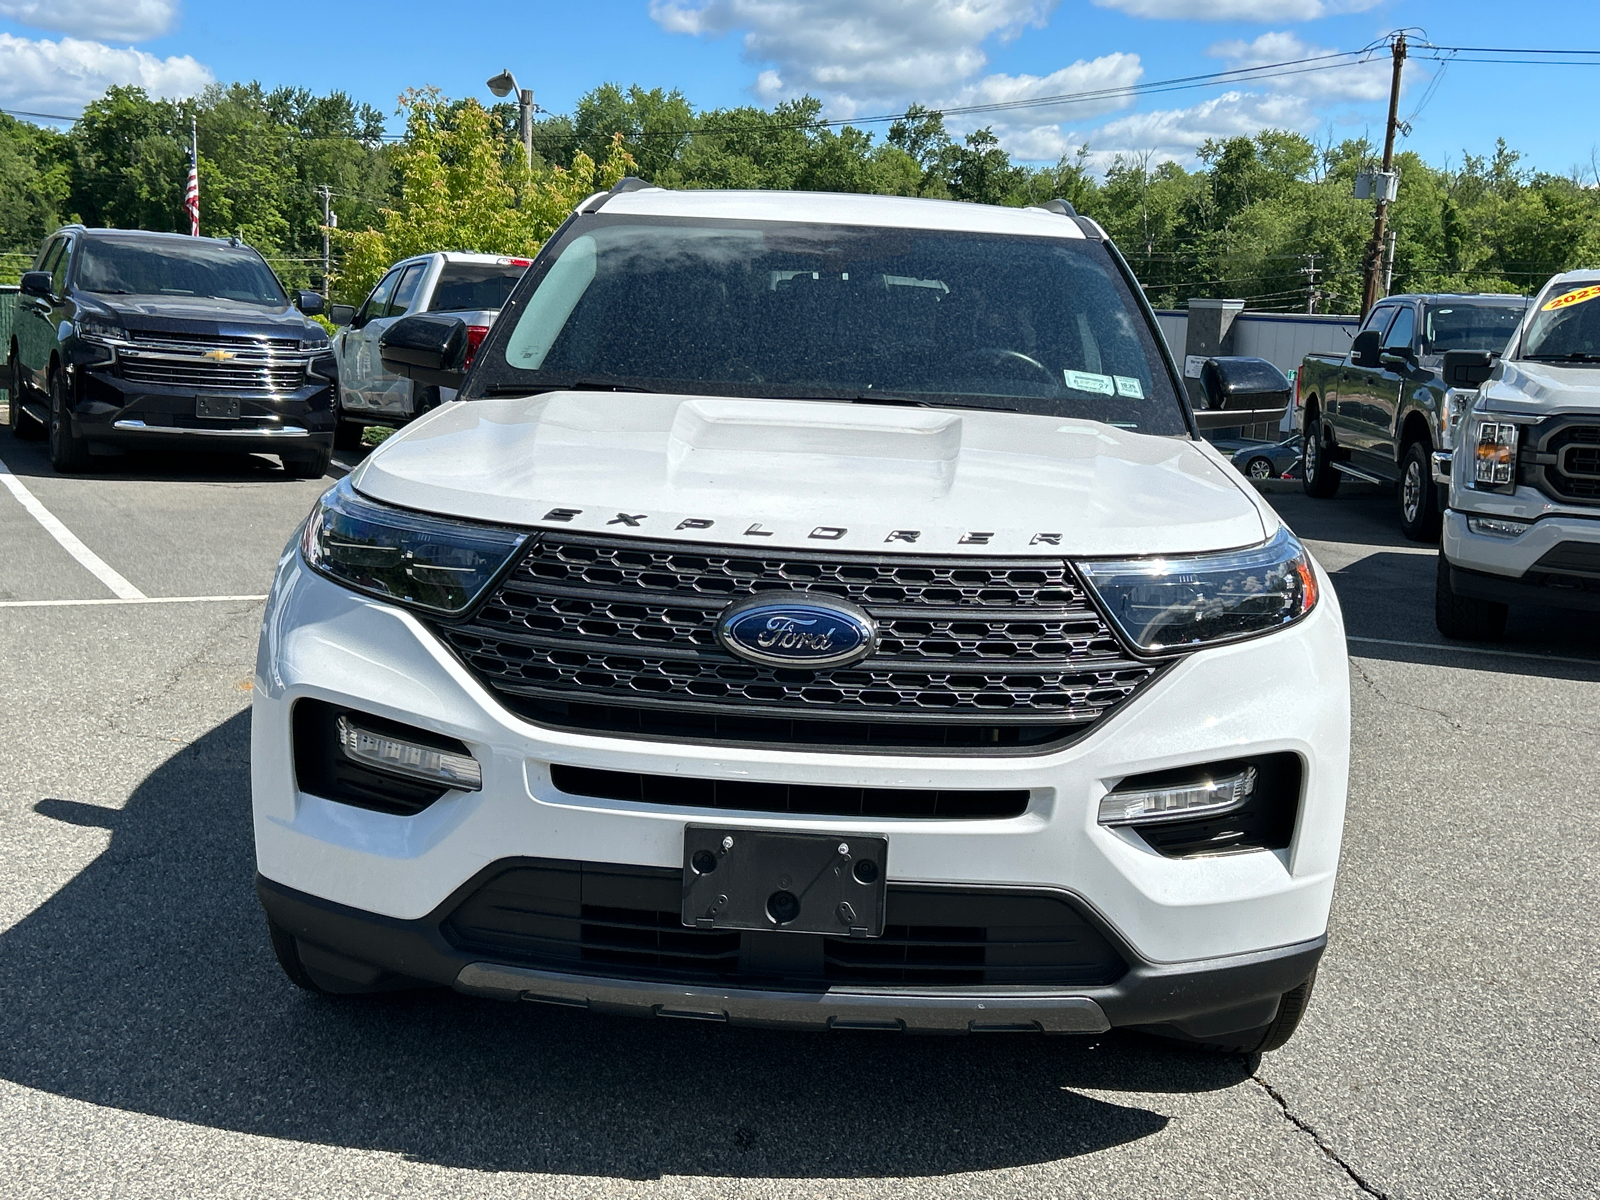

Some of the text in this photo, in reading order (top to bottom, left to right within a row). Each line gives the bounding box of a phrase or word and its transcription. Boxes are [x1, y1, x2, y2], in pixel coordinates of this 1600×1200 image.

[1551, 287, 1600, 309] 2023
[541, 508, 1064, 546] EXPLORER
[757, 616, 836, 651] Ford
